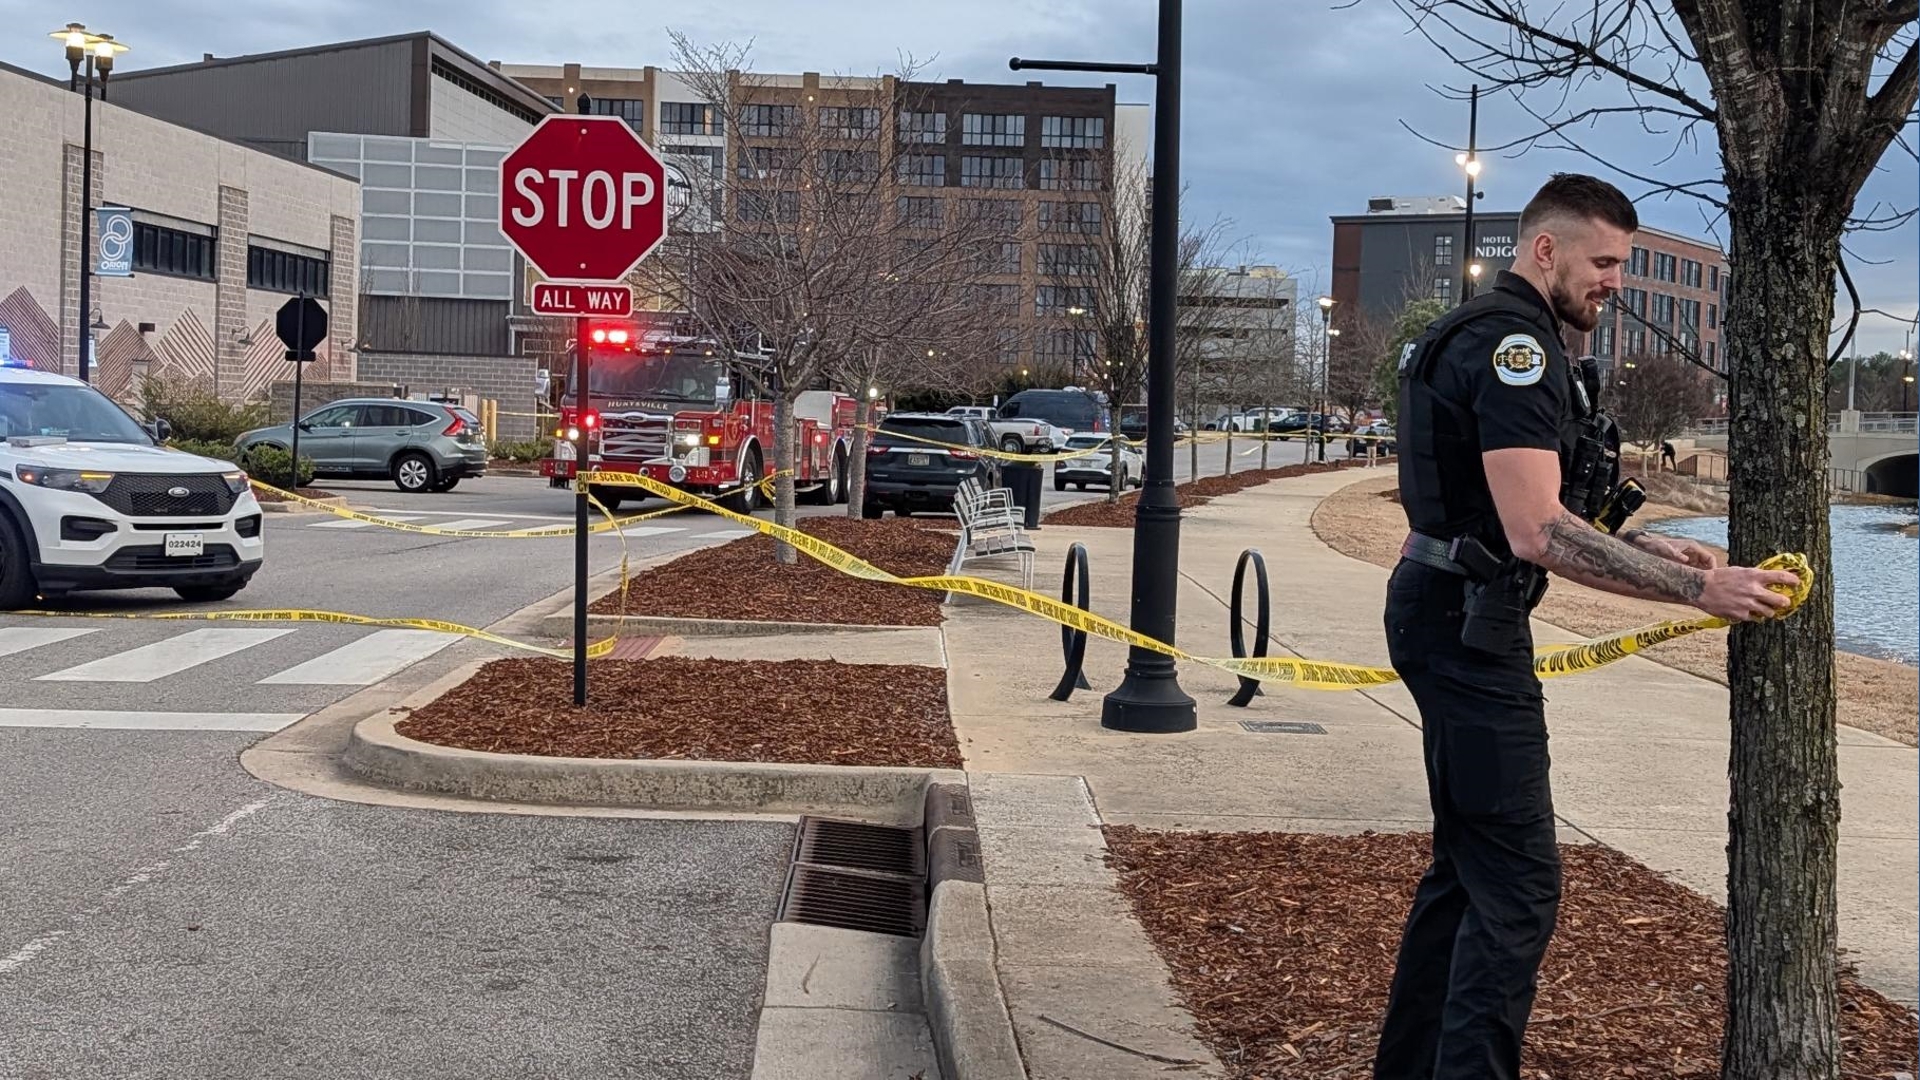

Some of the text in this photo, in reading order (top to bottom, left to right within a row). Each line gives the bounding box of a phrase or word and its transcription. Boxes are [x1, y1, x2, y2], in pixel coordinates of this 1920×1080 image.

[512, 167, 655, 229] STOP
[669, 185, 690, 206] OINT
[1482, 236, 1512, 244] HOTEL
[1475, 246, 1518, 257] NDIG
[101, 261, 129, 270] ORION
[541, 289, 624, 310] ALL WAY
[607, 401, 668, 410] HUNTSVILLE
[577, 472, 597, 481] RIME
[599, 472, 624, 482] SCENE
[168, 540, 201, 548] 022424
[1550, 650, 1565, 673] DO
[1566, 645, 1589, 670] NOT
[1587, 637, 1623, 664] CROSS
